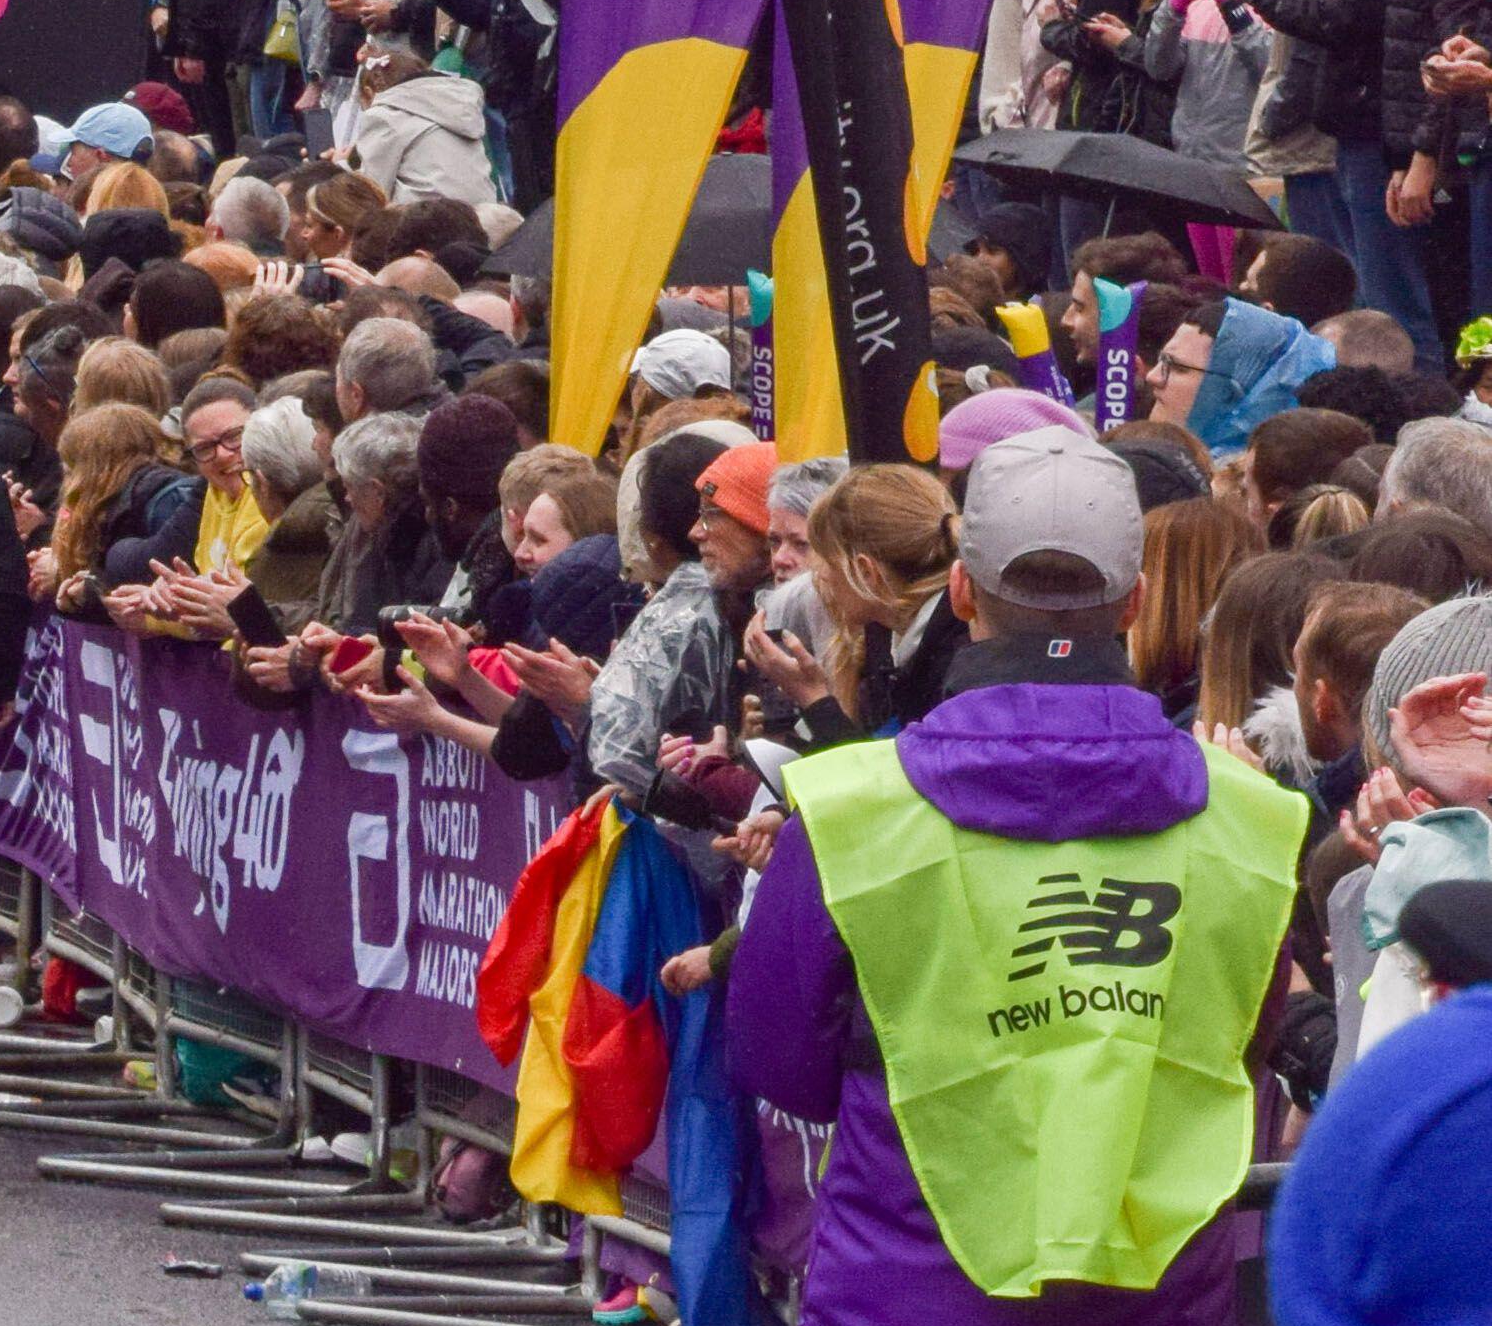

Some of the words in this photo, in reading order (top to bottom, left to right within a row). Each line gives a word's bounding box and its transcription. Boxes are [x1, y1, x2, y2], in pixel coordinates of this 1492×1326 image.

[754, 346, 772, 420] SCOPE
[420, 799, 479, 861] WORLD
[415, 939, 479, 1009] MAJORS
[987, 998, 1053, 1038] new
